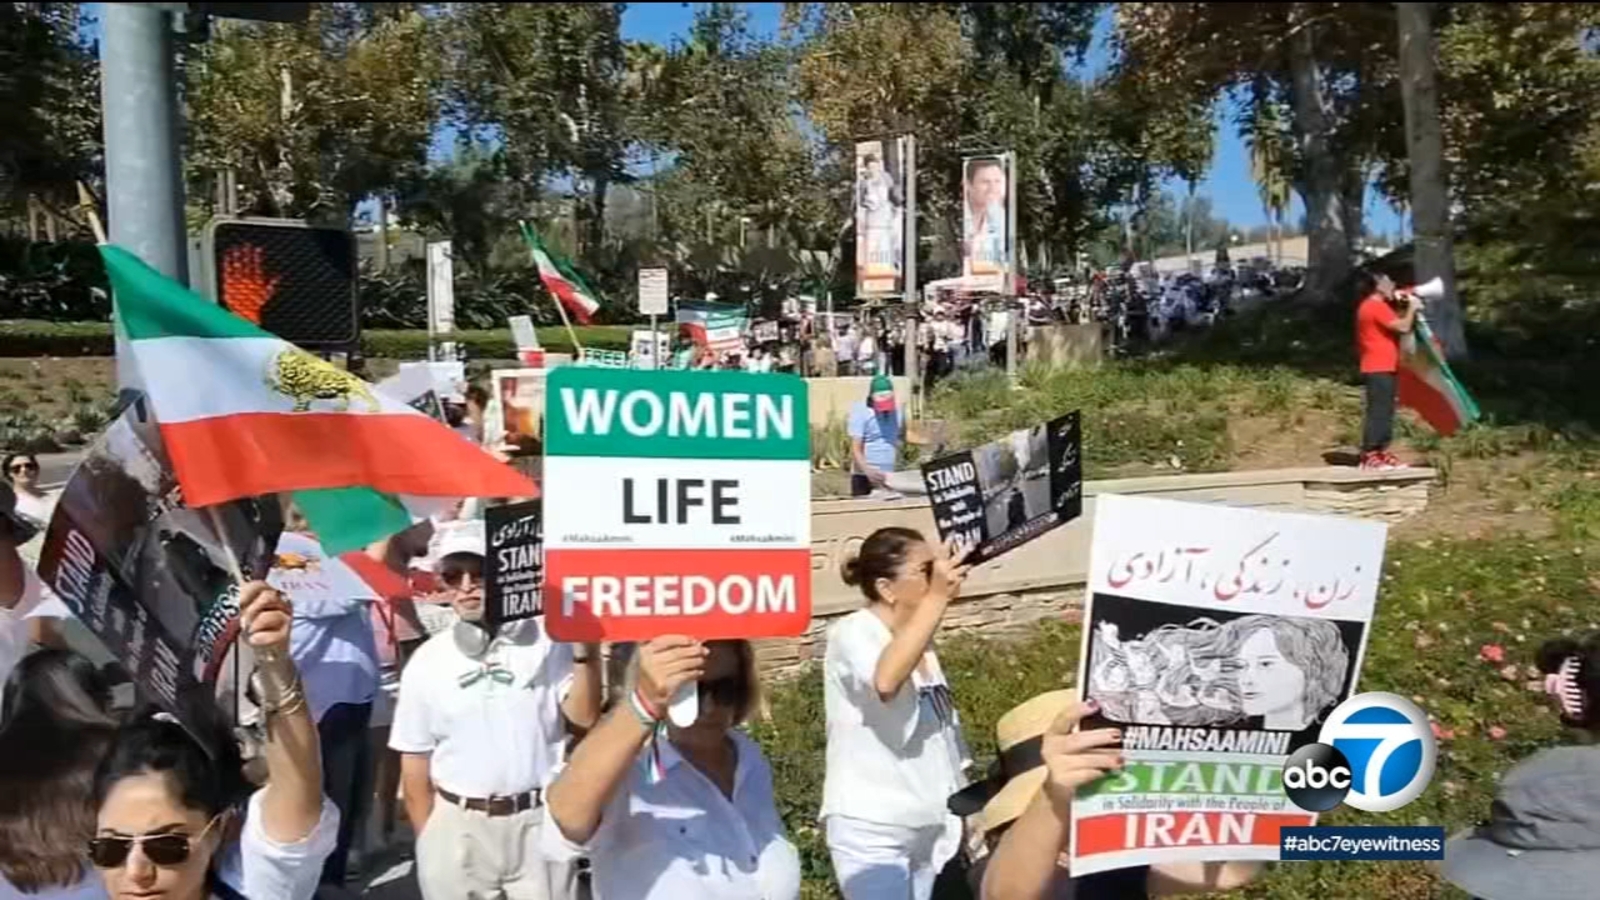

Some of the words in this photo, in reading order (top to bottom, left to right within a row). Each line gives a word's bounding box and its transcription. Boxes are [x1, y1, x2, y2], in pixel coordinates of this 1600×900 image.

[560, 387, 794, 440] WOMEN
[927, 462, 975, 492] STAND
[622, 477, 741, 525] LIFE
[55, 529, 95, 614] STAND
[498, 544, 543, 573] STAN
[1107, 547, 1211, 589] آزادی
[503, 590, 543, 617] IRAN
[561, 574, 796, 618] FREEDOM
[151, 637, 181, 706] IRAN
[1123, 725, 1292, 755] #MAHSAAMINI
[1103, 799, 1114, 810] in
[1118, 797, 1173, 811] Solidarity
[1177, 798, 1204, 809] with
[1206, 798, 1226, 809] the
[1230, 798, 1269, 811] People
[1273, 799, 1286, 811] of
[1125, 813, 1257, 848] IRAN
